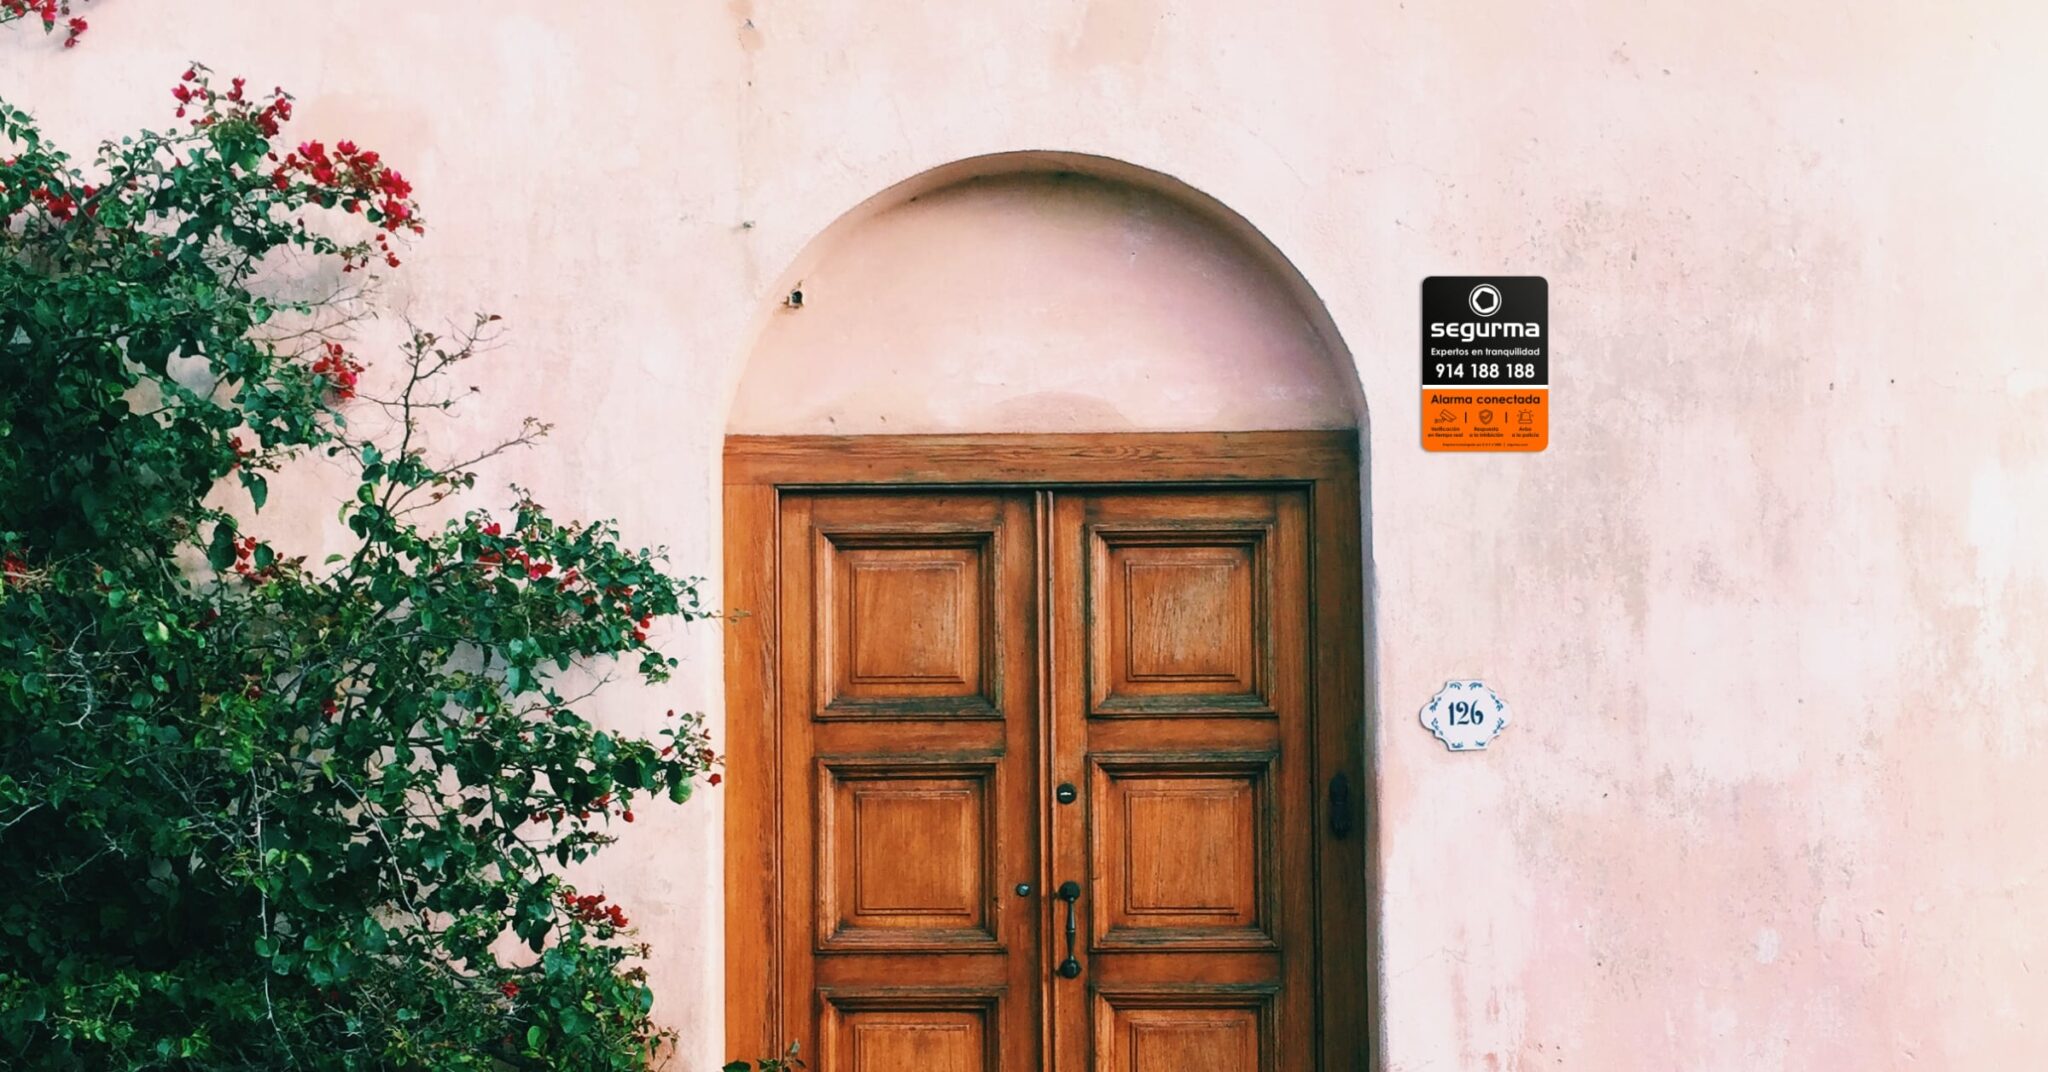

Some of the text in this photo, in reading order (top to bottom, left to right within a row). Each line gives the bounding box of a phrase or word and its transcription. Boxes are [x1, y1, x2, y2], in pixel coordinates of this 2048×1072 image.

[1430, 322, 1540, 342] segurma
[1431, 348, 1469, 357] Expertos
[1486, 347, 1540, 358] tranquilidad
[1436, 363, 1535, 378] 914 188 188
[1431, 394, 1540, 404] Alarma conectada
[1448, 700, 1484, 726] 126
